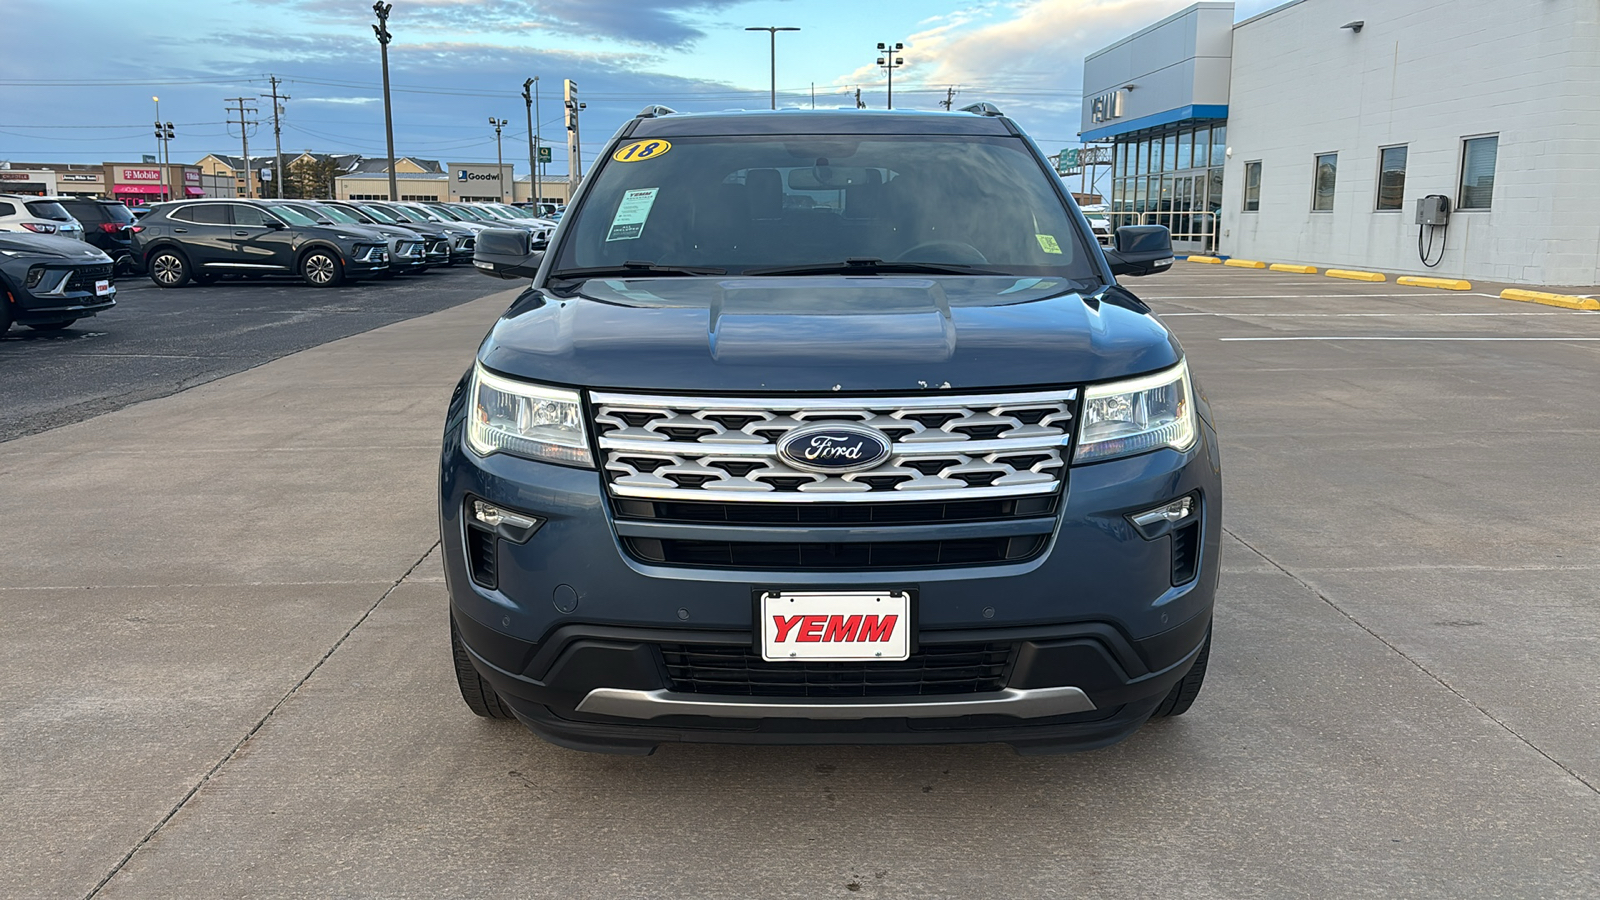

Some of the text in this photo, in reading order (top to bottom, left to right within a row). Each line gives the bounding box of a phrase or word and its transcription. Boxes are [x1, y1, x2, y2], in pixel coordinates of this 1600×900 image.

[623, 142, 660, 160] 18
[133, 170, 159, 179] Mobile
[468, 172, 503, 180] Goodwi
[804, 435, 863, 460] Ford
[773, 615, 899, 643] YEMM
